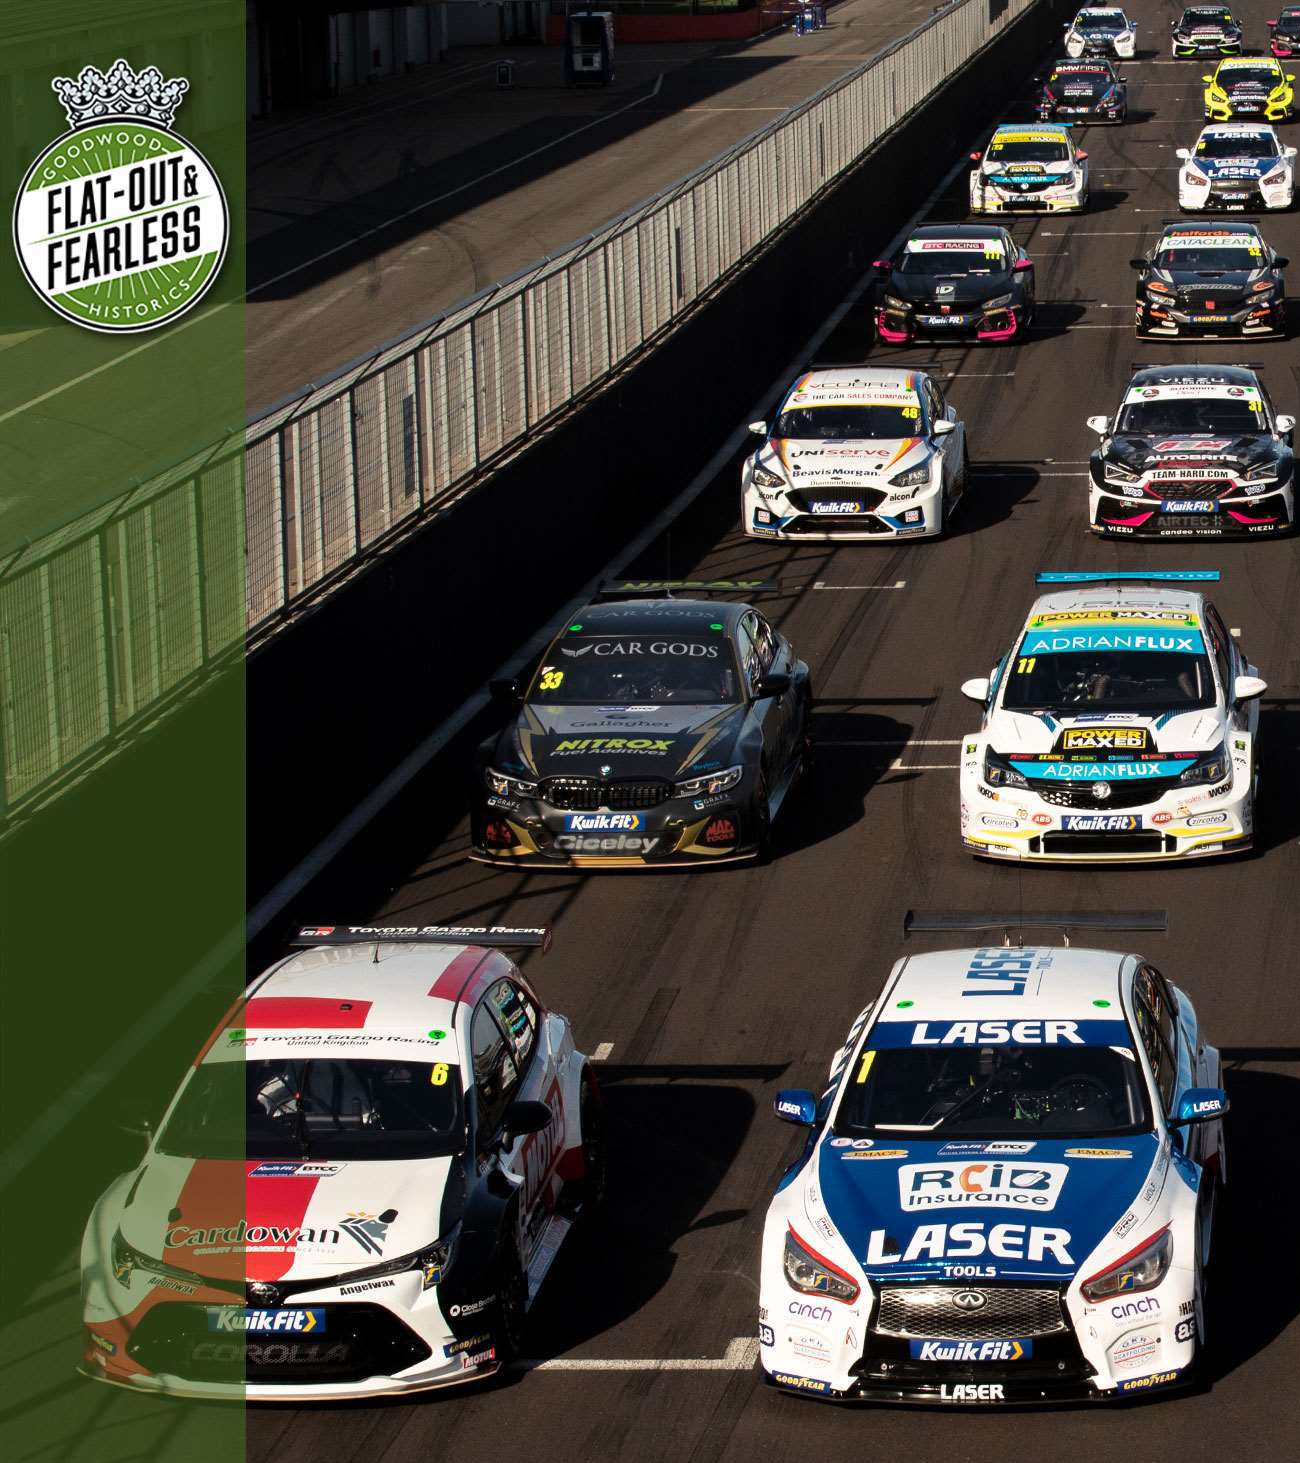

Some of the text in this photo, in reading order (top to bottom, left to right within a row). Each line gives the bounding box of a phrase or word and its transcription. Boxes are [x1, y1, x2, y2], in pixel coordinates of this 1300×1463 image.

[1208, 168, 1261, 177] LASER
[1166, 238, 1252, 246] CATACLEAN
[902, 408, 918, 418] 48
[1249, 401, 1263, 411] 31
[890, 493, 910, 501] alcon
[812, 502, 854, 512] KwikFit
[1166, 501, 1208, 511] KwikFit
[1157, 516, 1208, 525] AIRTEC
[1040, 612, 1189, 620] POWER MAXED
[594, 642, 719, 658] CAR GODS
[1018, 658, 1036, 673] 11
[540, 671, 564, 690] 33
[570, 720, 672, 729] Gallagher
[1066, 730, 1142, 739] POWER
[555, 739, 676, 751] NITROX
[1066, 738, 1144, 748] MAXED
[570, 814, 630, 830] KwikFit
[1068, 816, 1128, 830] KwikFit
[553, 835, 660, 853] Ciceley
[911, 1020, 1085, 1045] LASER
[386, 1036, 440, 1046] Racing
[857, 1050, 876, 1083] 1
[431, 1063, 449, 1086] 6
[778, 1101, 801, 1115] LASER
[1193, 1099, 1220, 1113] LASER
[909, 1192, 1048, 1206] Insurance
[165, 1220, 340, 1248] Cardowan
[866, 1222, 1075, 1265] LASER
[943, 1267, 997, 1278] TOOLS
[340, 1279, 395, 1296] Angelwax
[788, 1300, 832, 1322] cinch
[1111, 1297, 1160, 1319] cinch
[217, 1310, 304, 1330] KwikFit
[919, 1340, 1010, 1360] KwikFit
[775, 1375, 826, 1391] GOODYEAR
[1123, 1371, 1179, 1390] GOODYEAR
[940, 1384, 1005, 1399] LASER
